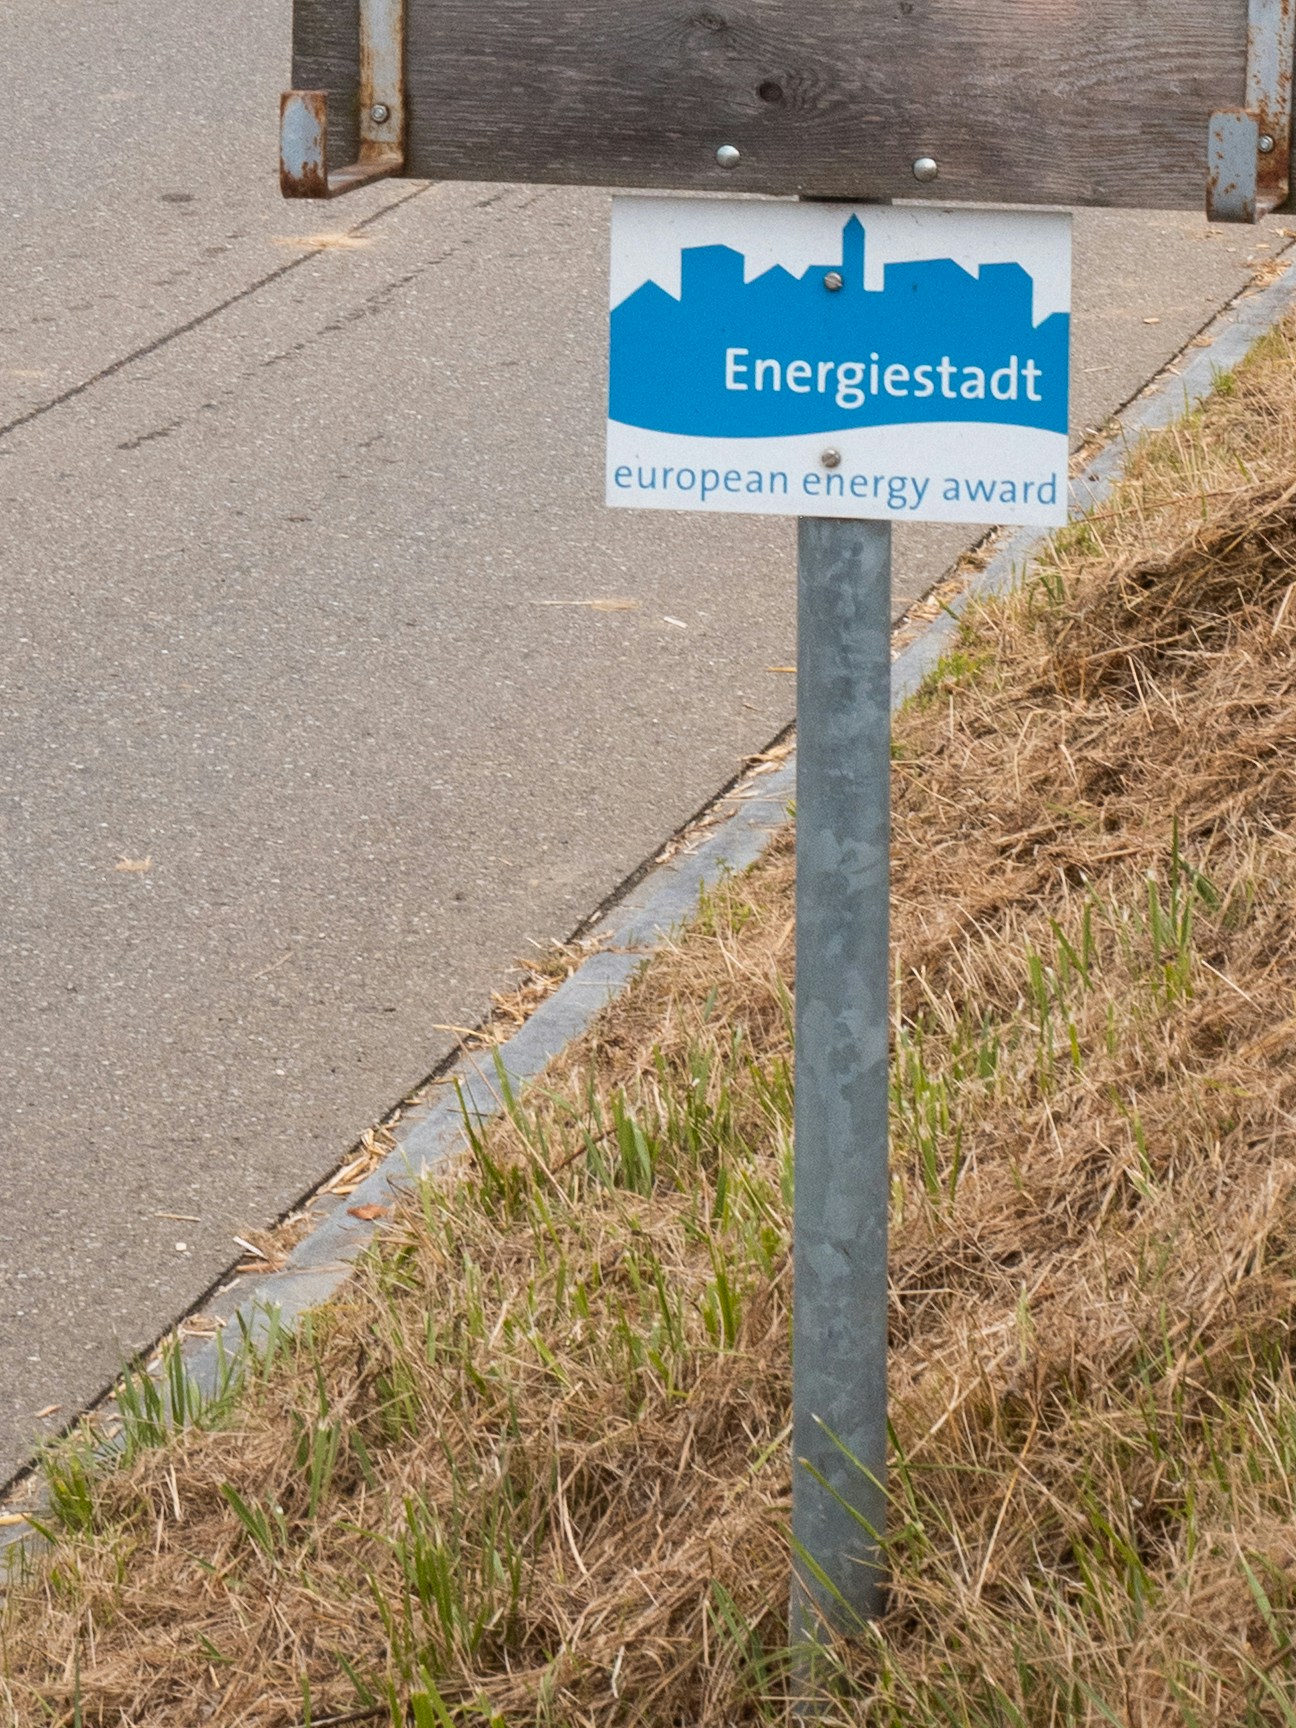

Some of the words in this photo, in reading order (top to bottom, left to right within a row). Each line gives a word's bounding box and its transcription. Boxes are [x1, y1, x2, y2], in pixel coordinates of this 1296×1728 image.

[725, 347, 1042, 409] Energiestadt
[614, 465, 788, 502] european
[802, 472, 930, 511] energy
[942, 472, 1057, 505] award
